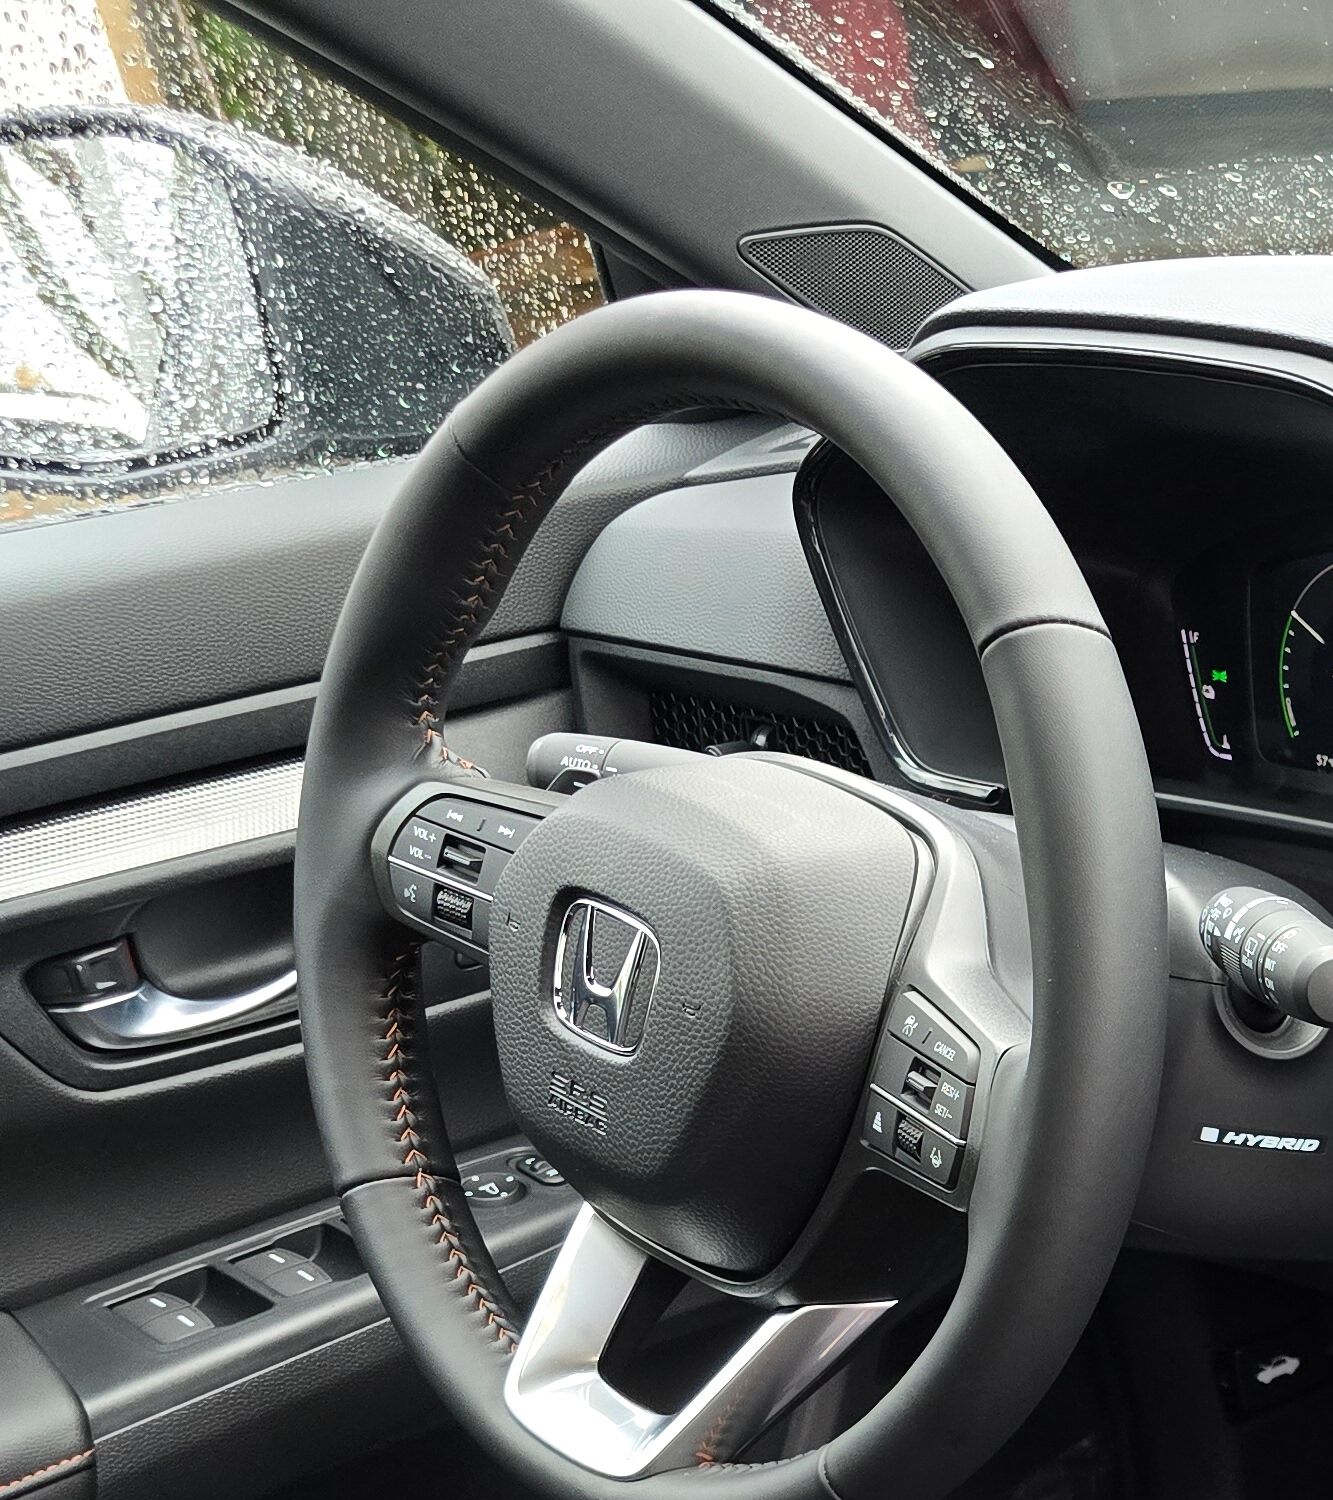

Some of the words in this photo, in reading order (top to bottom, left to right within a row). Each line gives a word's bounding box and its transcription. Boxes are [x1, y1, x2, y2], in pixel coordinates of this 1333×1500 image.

[576, 743, 599, 755] OFF
[560, 755, 591, 768] AUTO
[933, 1041, 956, 1062] CANCEL
[1222, 1131, 1321, 1152] HYBRID
